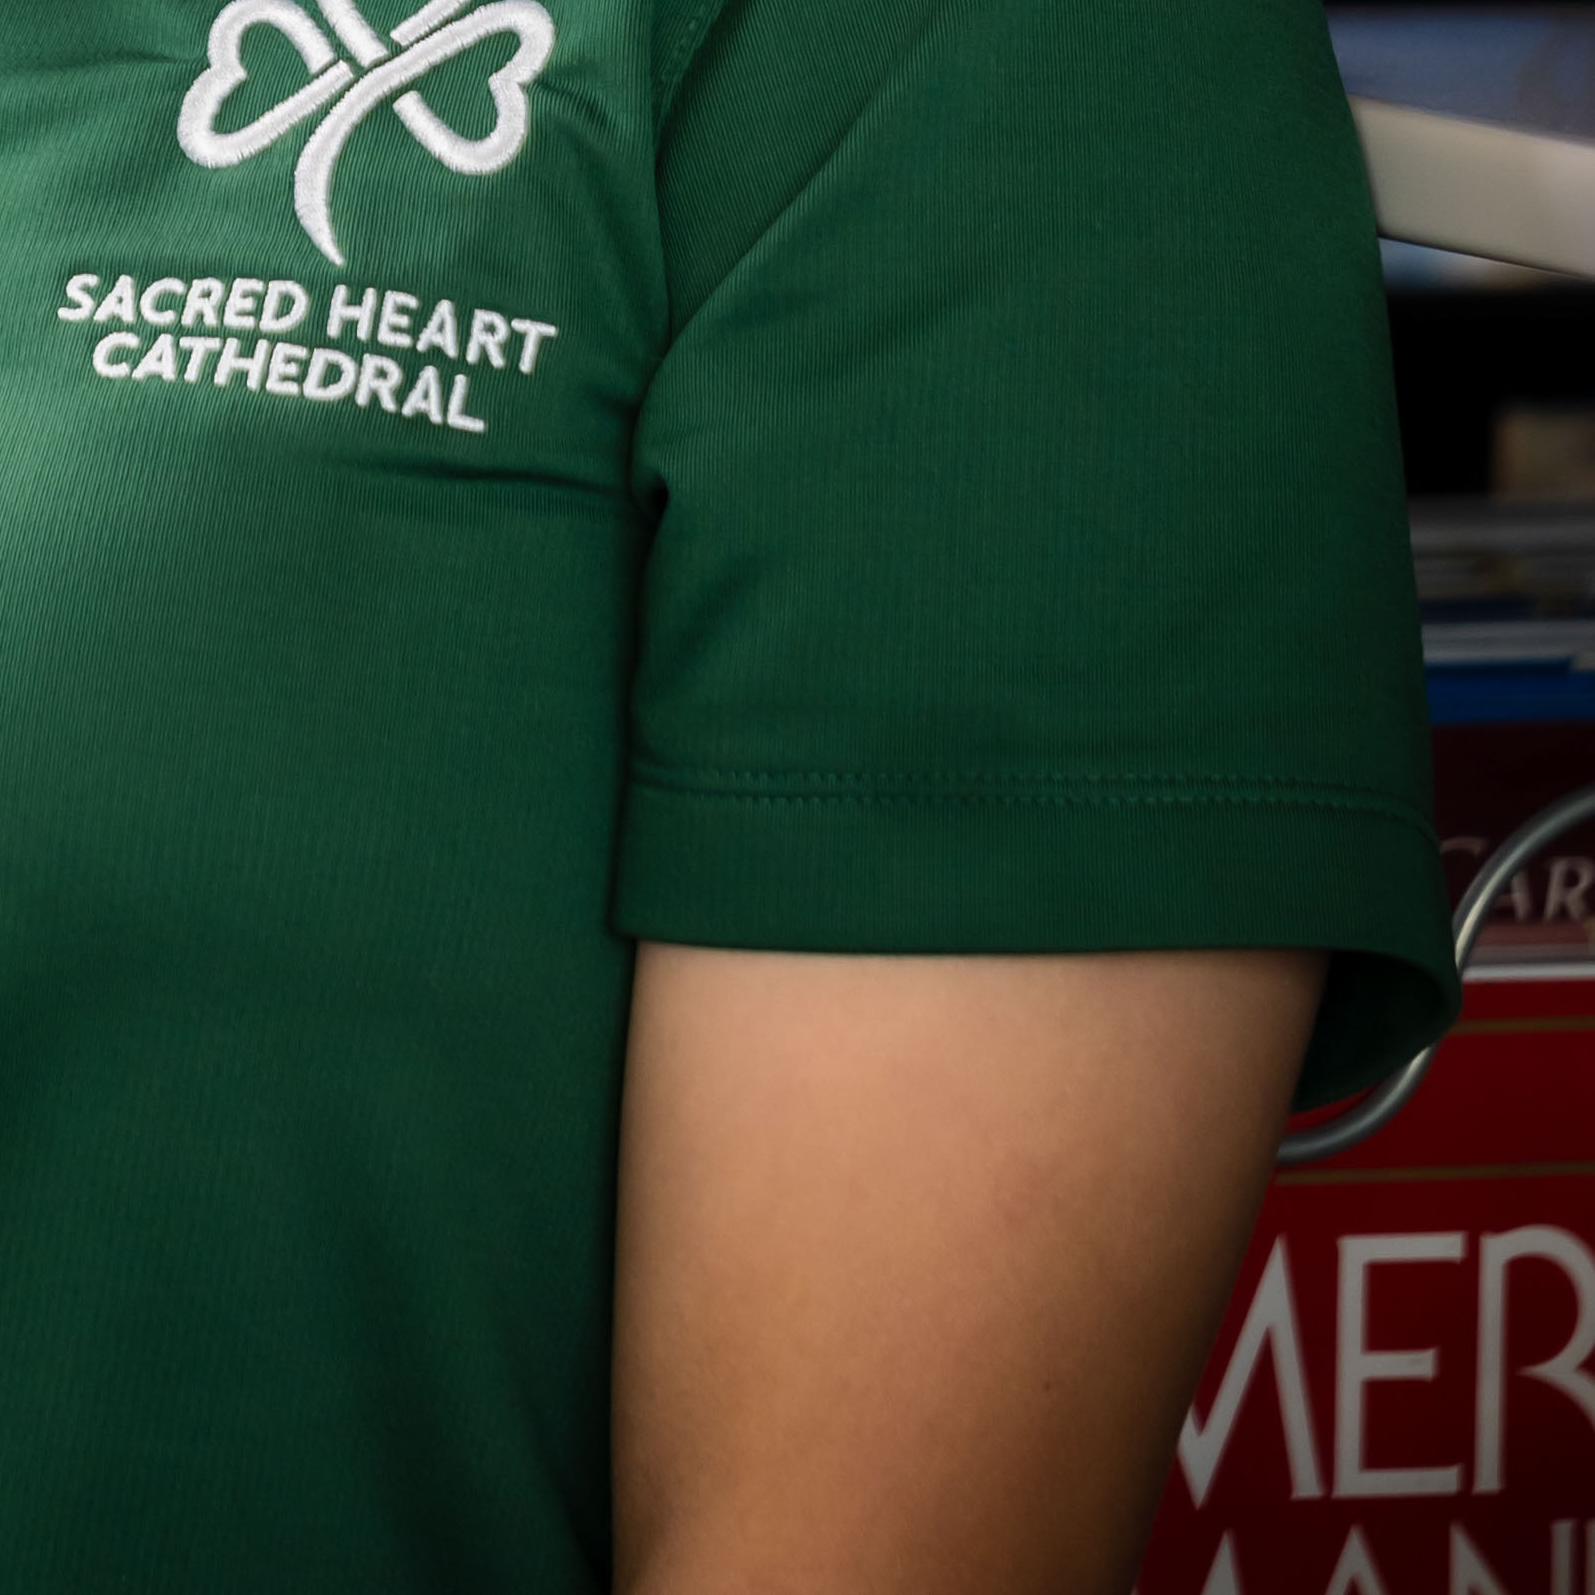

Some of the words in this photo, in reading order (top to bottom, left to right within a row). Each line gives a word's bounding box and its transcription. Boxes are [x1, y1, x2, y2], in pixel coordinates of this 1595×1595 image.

[57, 273, 307, 333] SACRED
[326, 284, 559, 375] HEART
[92, 332, 487, 433] CATHEDRAL
